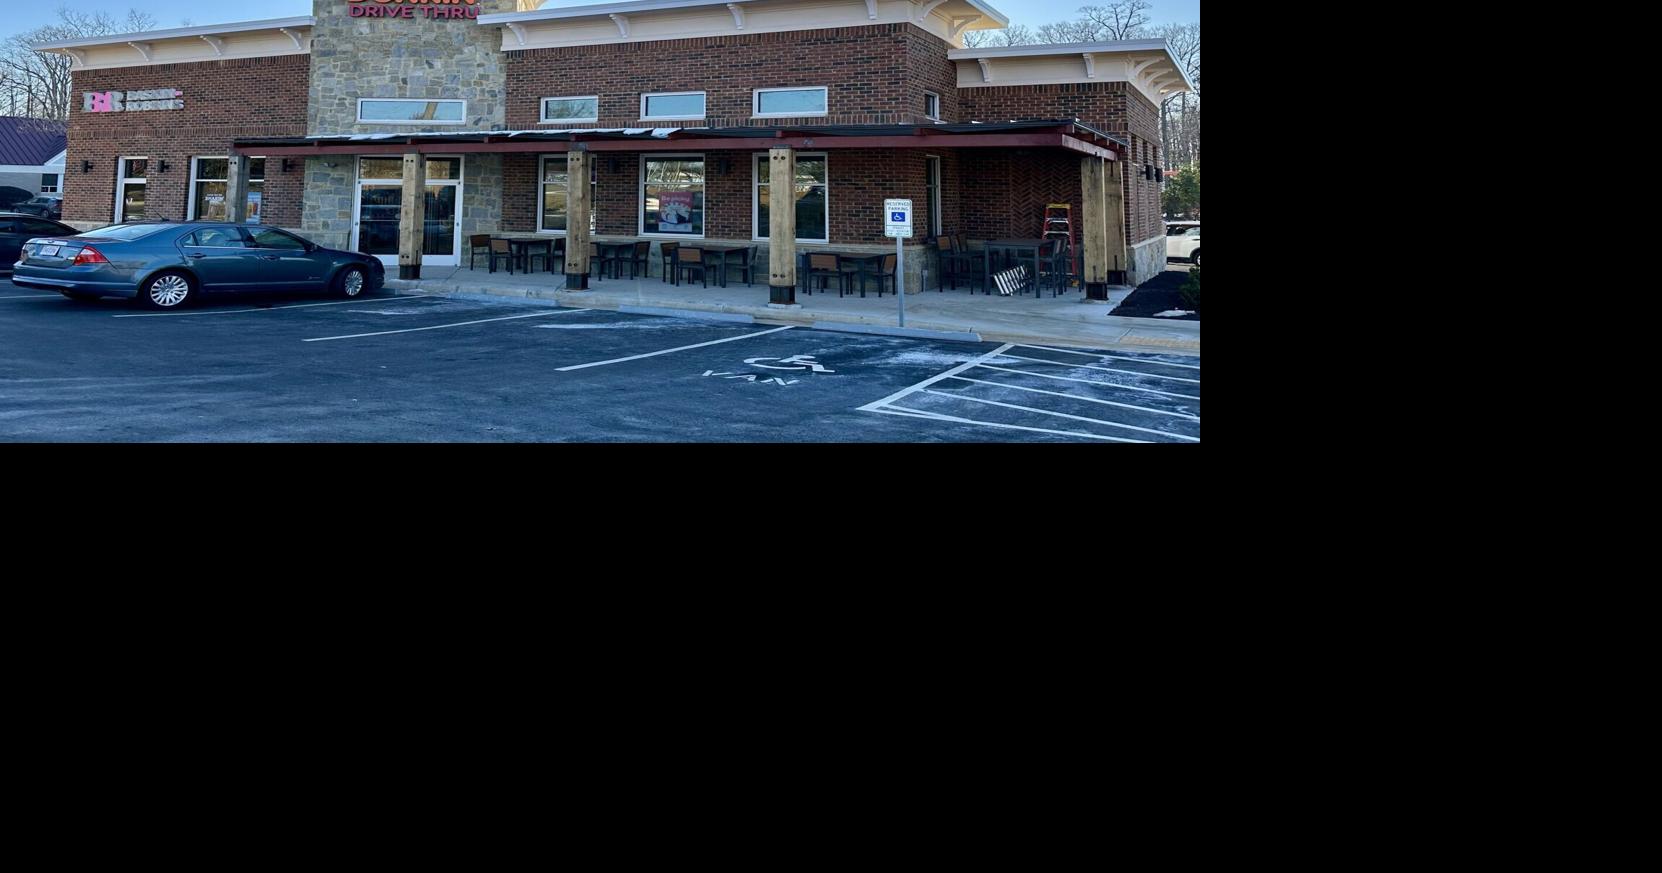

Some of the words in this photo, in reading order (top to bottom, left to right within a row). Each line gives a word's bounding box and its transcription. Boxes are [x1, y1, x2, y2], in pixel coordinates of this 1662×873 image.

[348, 5, 415, 18] DRIVE
[420, 6, 481, 19] THRU
[702, 370, 800, 385] VAN
